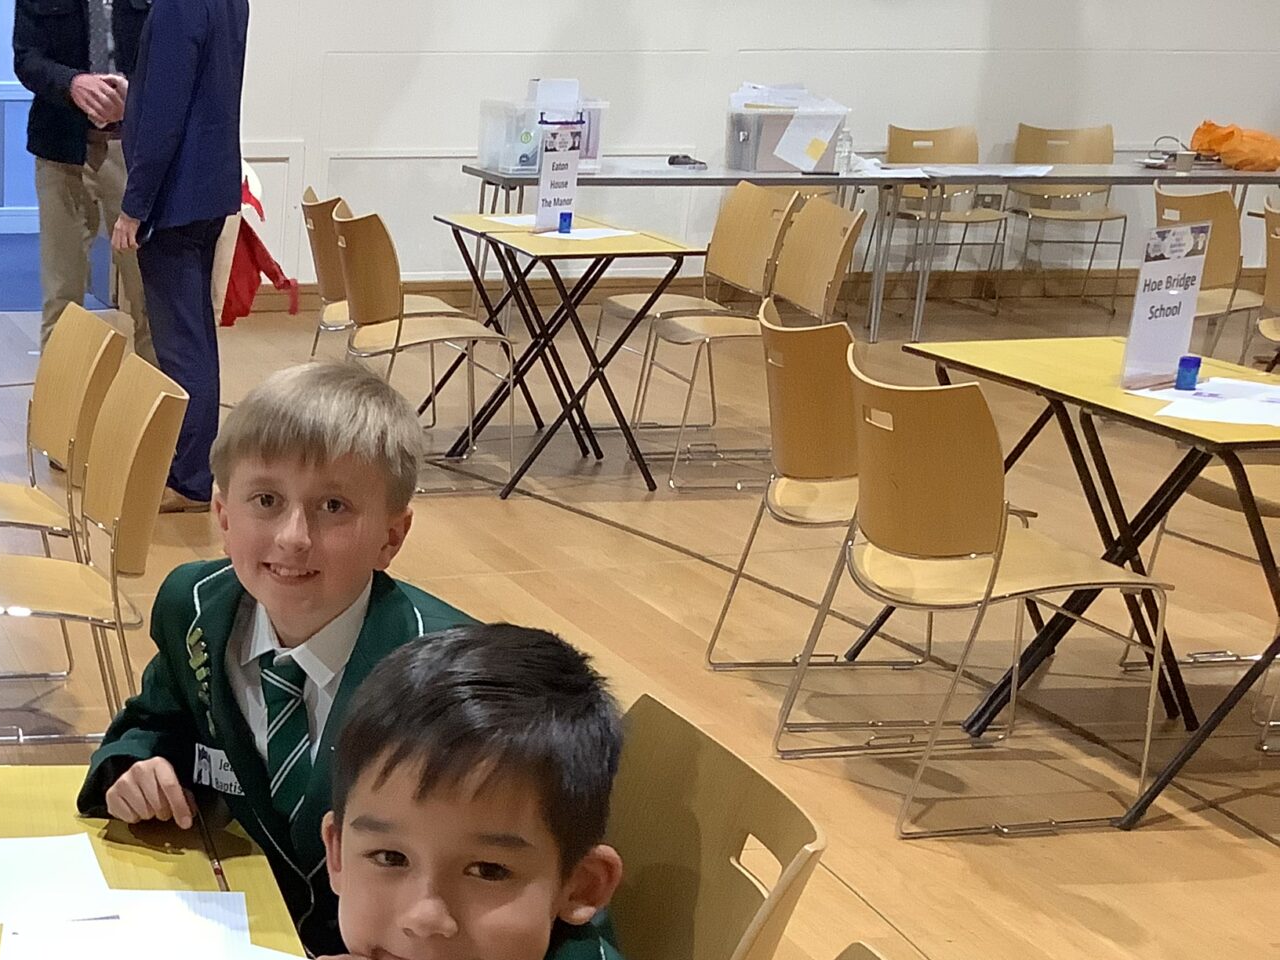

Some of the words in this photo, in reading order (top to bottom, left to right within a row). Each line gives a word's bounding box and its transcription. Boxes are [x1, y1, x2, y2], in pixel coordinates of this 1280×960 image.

[552, 161, 569, 172] Eaton
[550, 180, 569, 190] House
[541, 198, 552, 208] The
[553, 197, 573, 207] Manor
[1142, 278, 1163, 293] Hoe
[1165, 273, 1197, 291] Bridge
[1147, 301, 1182, 320] School
